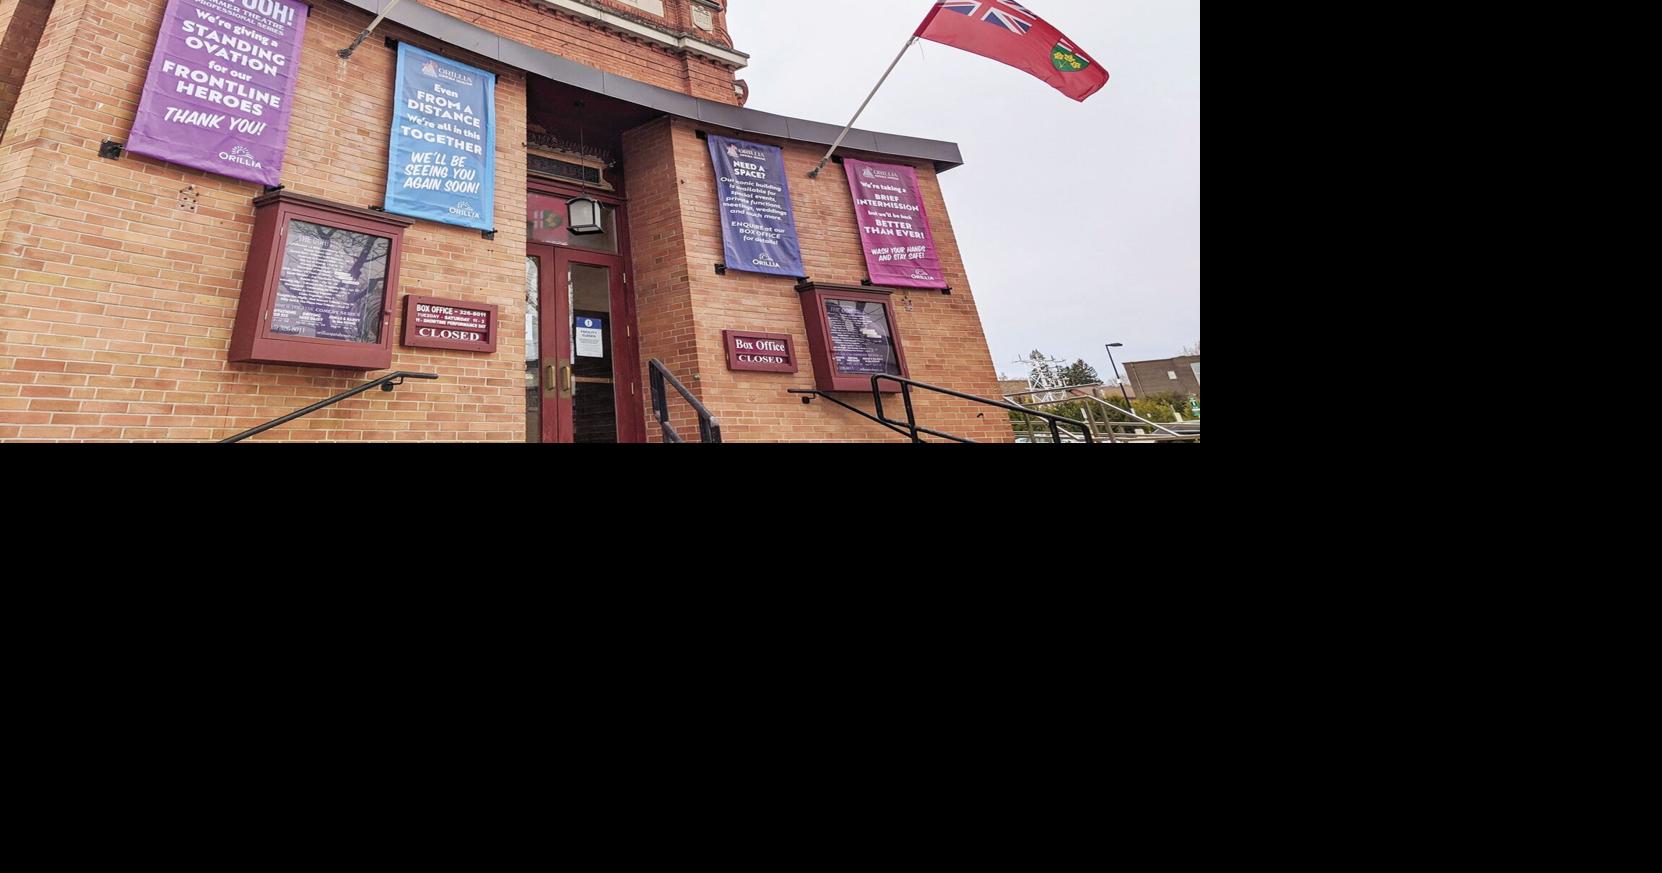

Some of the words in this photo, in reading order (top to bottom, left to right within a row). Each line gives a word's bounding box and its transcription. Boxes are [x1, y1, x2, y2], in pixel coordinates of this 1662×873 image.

[242, 9, 284, 31] THEATRE
[196, 8, 232, 29] We're
[233, 25, 270, 46] giving
[270, 40, 278, 48] a
[182, 20, 286, 66] STANDING
[185, 36, 278, 78] OVATION
[208, 60, 228, 74] for
[230, 70, 252, 82] our
[162, 60, 282, 108] FRONTLINE
[434, 83, 458, 98] Even
[176, 80, 264, 116] HEROES
[416, 90, 461, 110] FROM
[464, 105, 474, 115] A
[408, 99, 480, 128] DISTANCE
[164, 106, 226, 129] THANK
[228, 116, 268, 136] YOU!
[407, 113, 435, 128] We're
[437, 123, 452, 132] all
[454, 125, 462, 135] in
[464, 129, 481, 140] this
[401, 125, 482, 156] TOGETHER
[218, 151, 262, 170] ORILLIA
[411, 151, 446, 166] WE'LL
[450, 155, 467, 168] BE
[733, 160, 757, 170] NEED
[404, 164, 449, 179] SEEING
[453, 168, 476, 182] YOU
[734, 168, 766, 179] SPACE?
[403, 176, 442, 192] AGAIN
[444, 180, 480, 194] SOON!
[756, 182, 782, 192] building
[860, 180, 880, 190] We're
[880, 184, 902, 194] taking
[874, 193, 900, 202] BRIEF
[756, 207, 788, 216] weddings
[856, 198, 919, 212] INTERMISSION
[449, 207, 480, 220] ORILLIA
[732, 220, 764, 231] ENQUIRE
[875, 219, 912, 230] BETTER
[756, 230, 781, 239] OFFICE
[864, 226, 894, 236] THAN
[895, 230, 925, 240] EVER!
[871, 248, 890, 256] WASH
[906, 245, 926, 253] HANDS
[752, 258, 780, 268] ORILLIA
[416, 304, 431, 313] BOX
[432, 306, 454, 314] OFFICE
[419, 328, 480, 340] CLOSED
[736, 339, 754, 350] Box
[756, 340, 785, 352] Office
[738, 354, 784, 364] CLOSED
